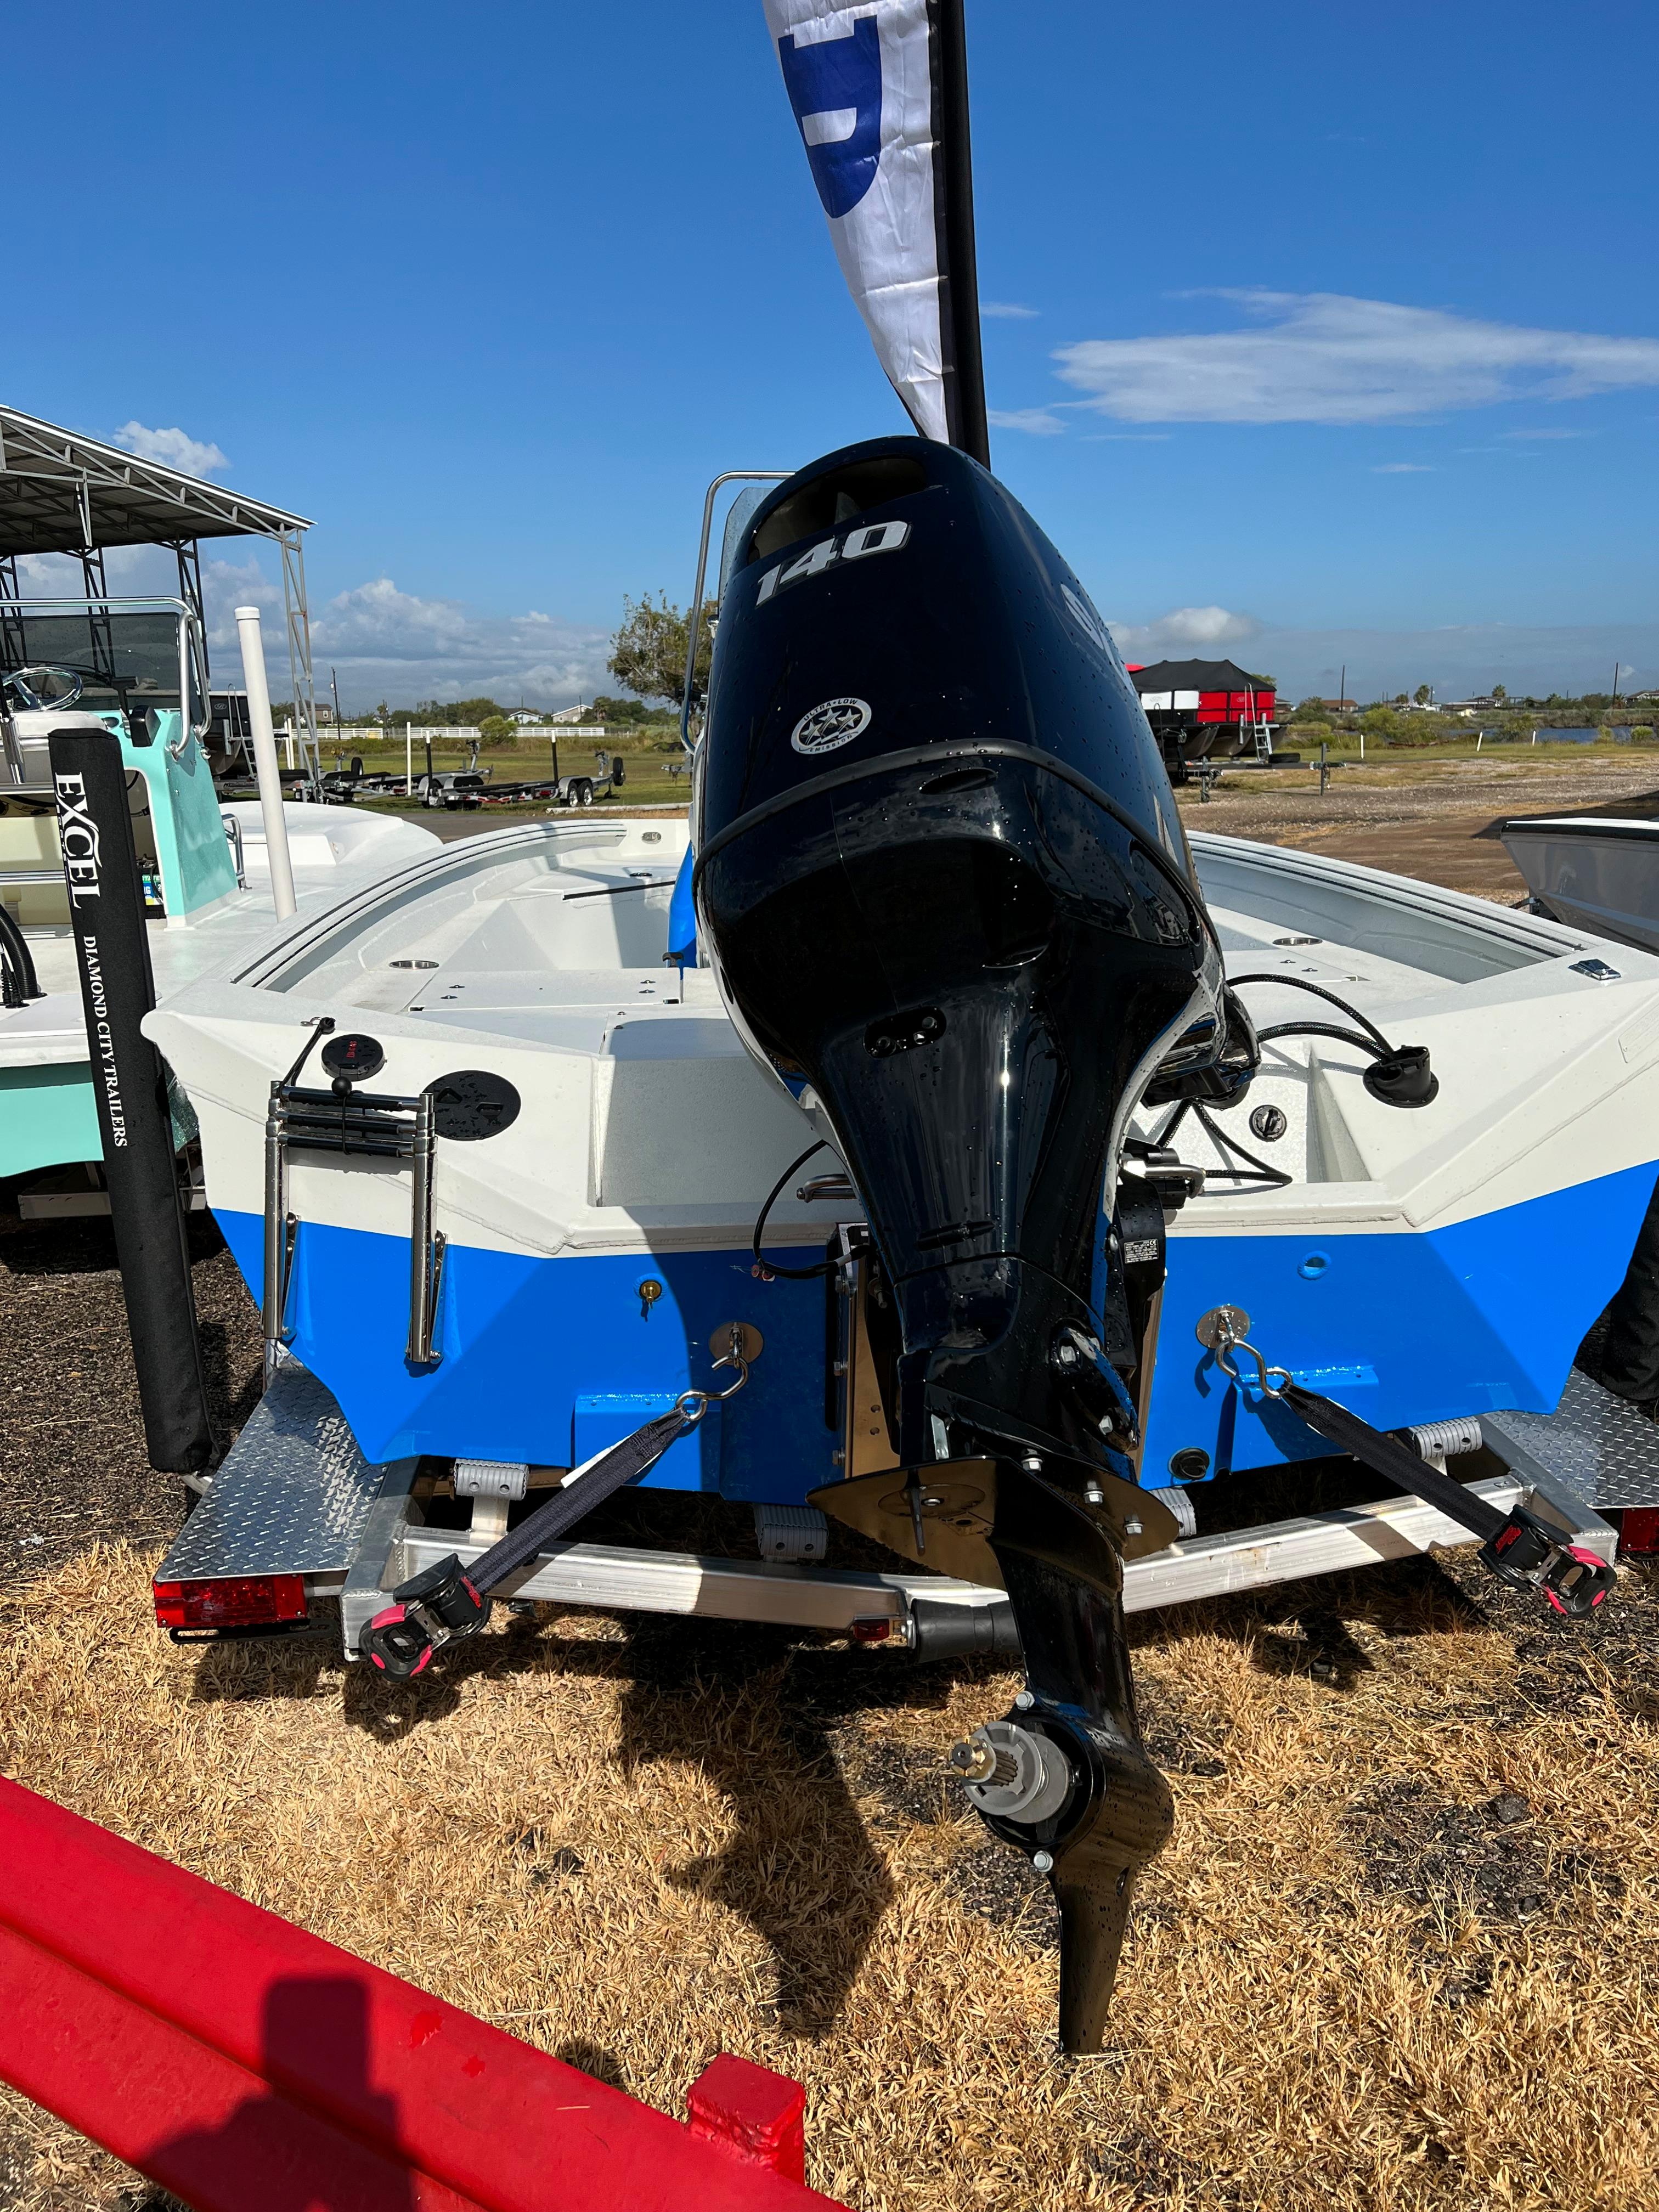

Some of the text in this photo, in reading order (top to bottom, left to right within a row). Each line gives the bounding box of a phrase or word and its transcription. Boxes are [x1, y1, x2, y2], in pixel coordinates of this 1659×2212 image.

[756, 520, 908, 606] 140
[804, 702, 831, 721] ULTRA
[55, 771, 103, 909] EXCEL
[83, 935, 127, 1147] DIAMOND CITY TRAILERS
